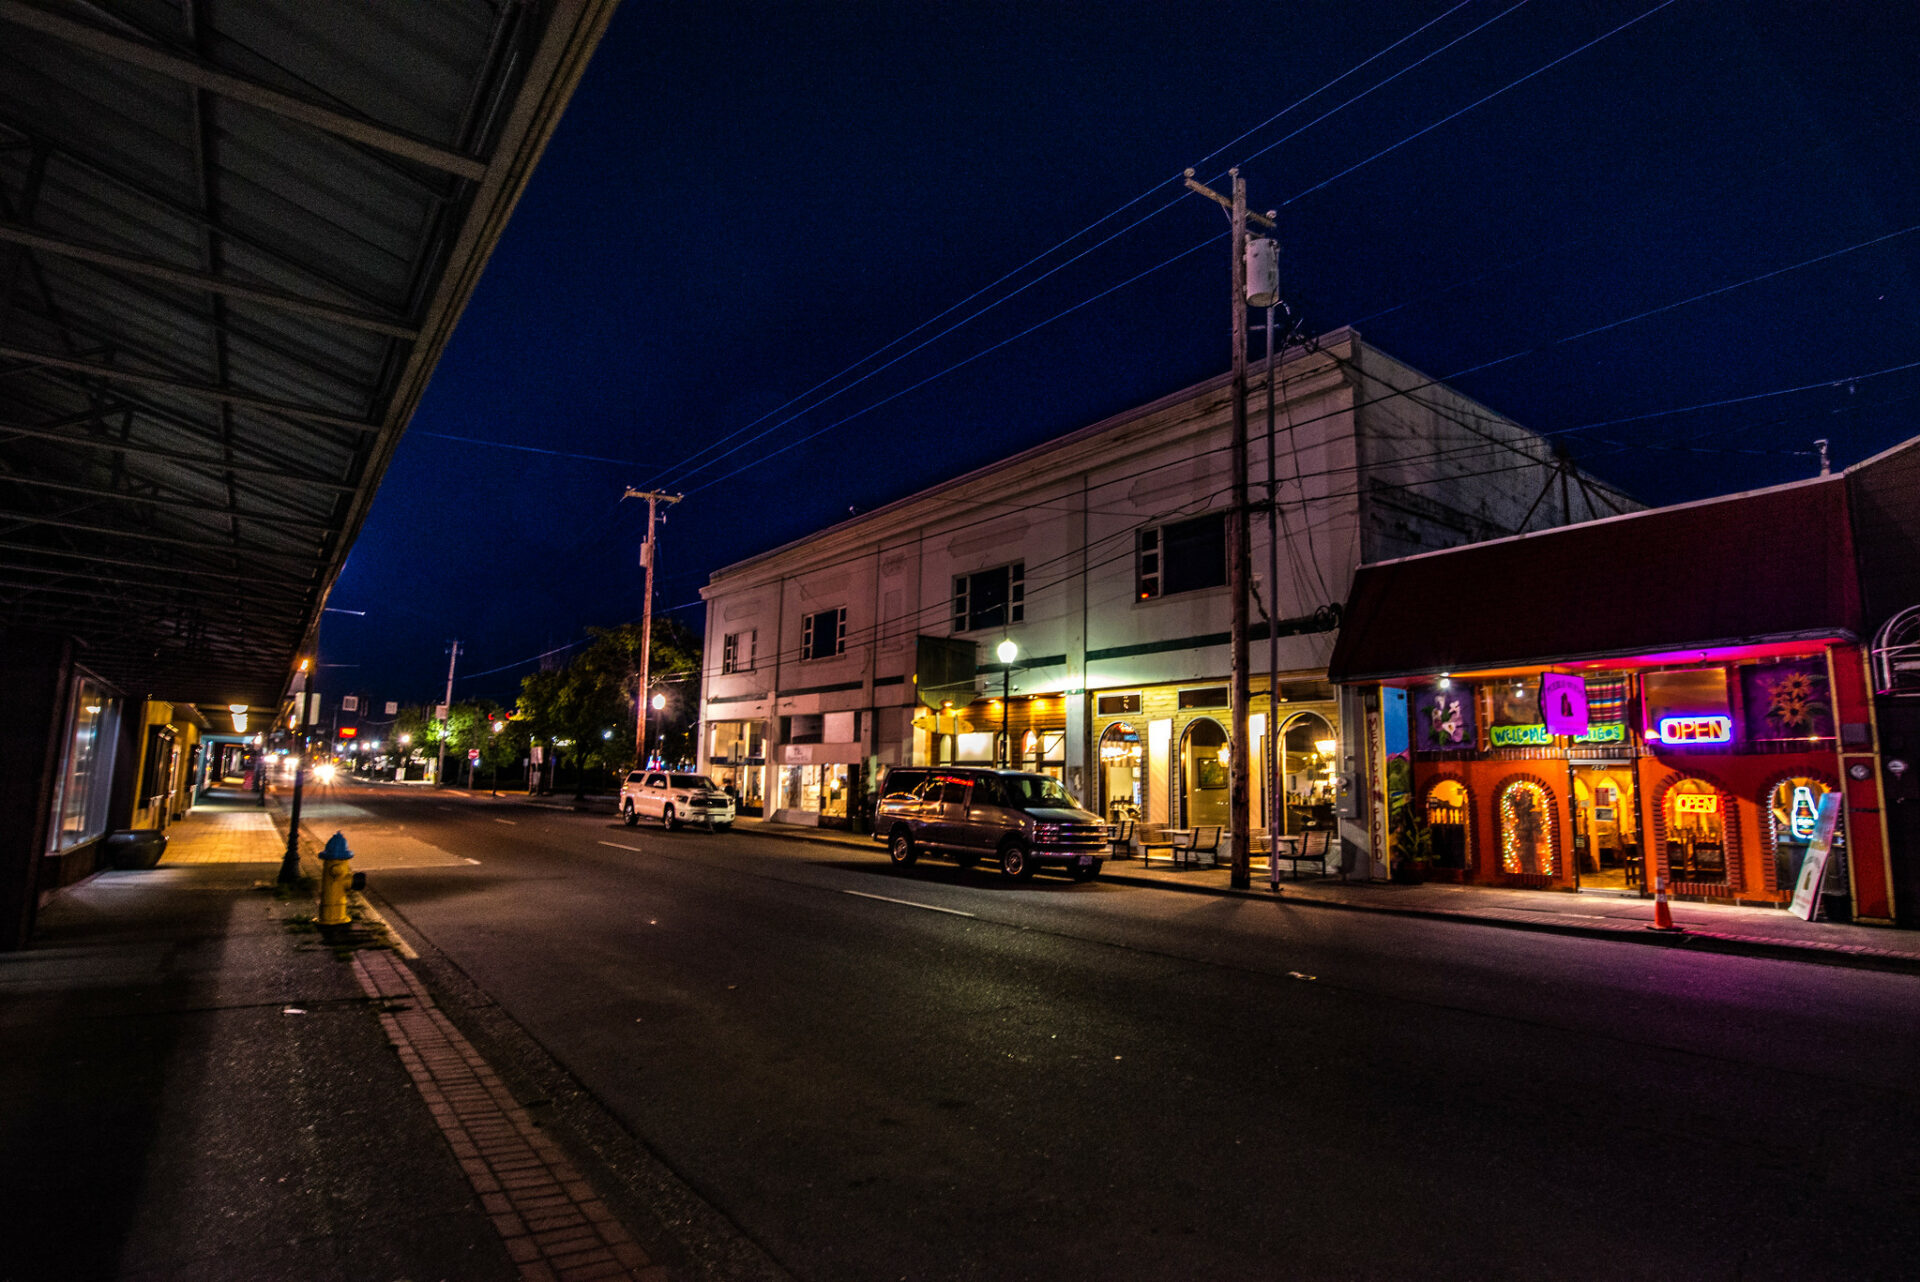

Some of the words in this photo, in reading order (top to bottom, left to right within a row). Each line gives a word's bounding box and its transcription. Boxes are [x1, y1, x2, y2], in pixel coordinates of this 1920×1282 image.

[1495, 726, 1548, 744] WELCOME
[1576, 726, 1620, 740] IGOS
[1667, 719, 1723, 740] OPEN
[1368, 717, 1383, 800] MEXICAN
[1678, 796, 1715, 811] OPEN
[1374, 807, 1383, 861] FOOD
